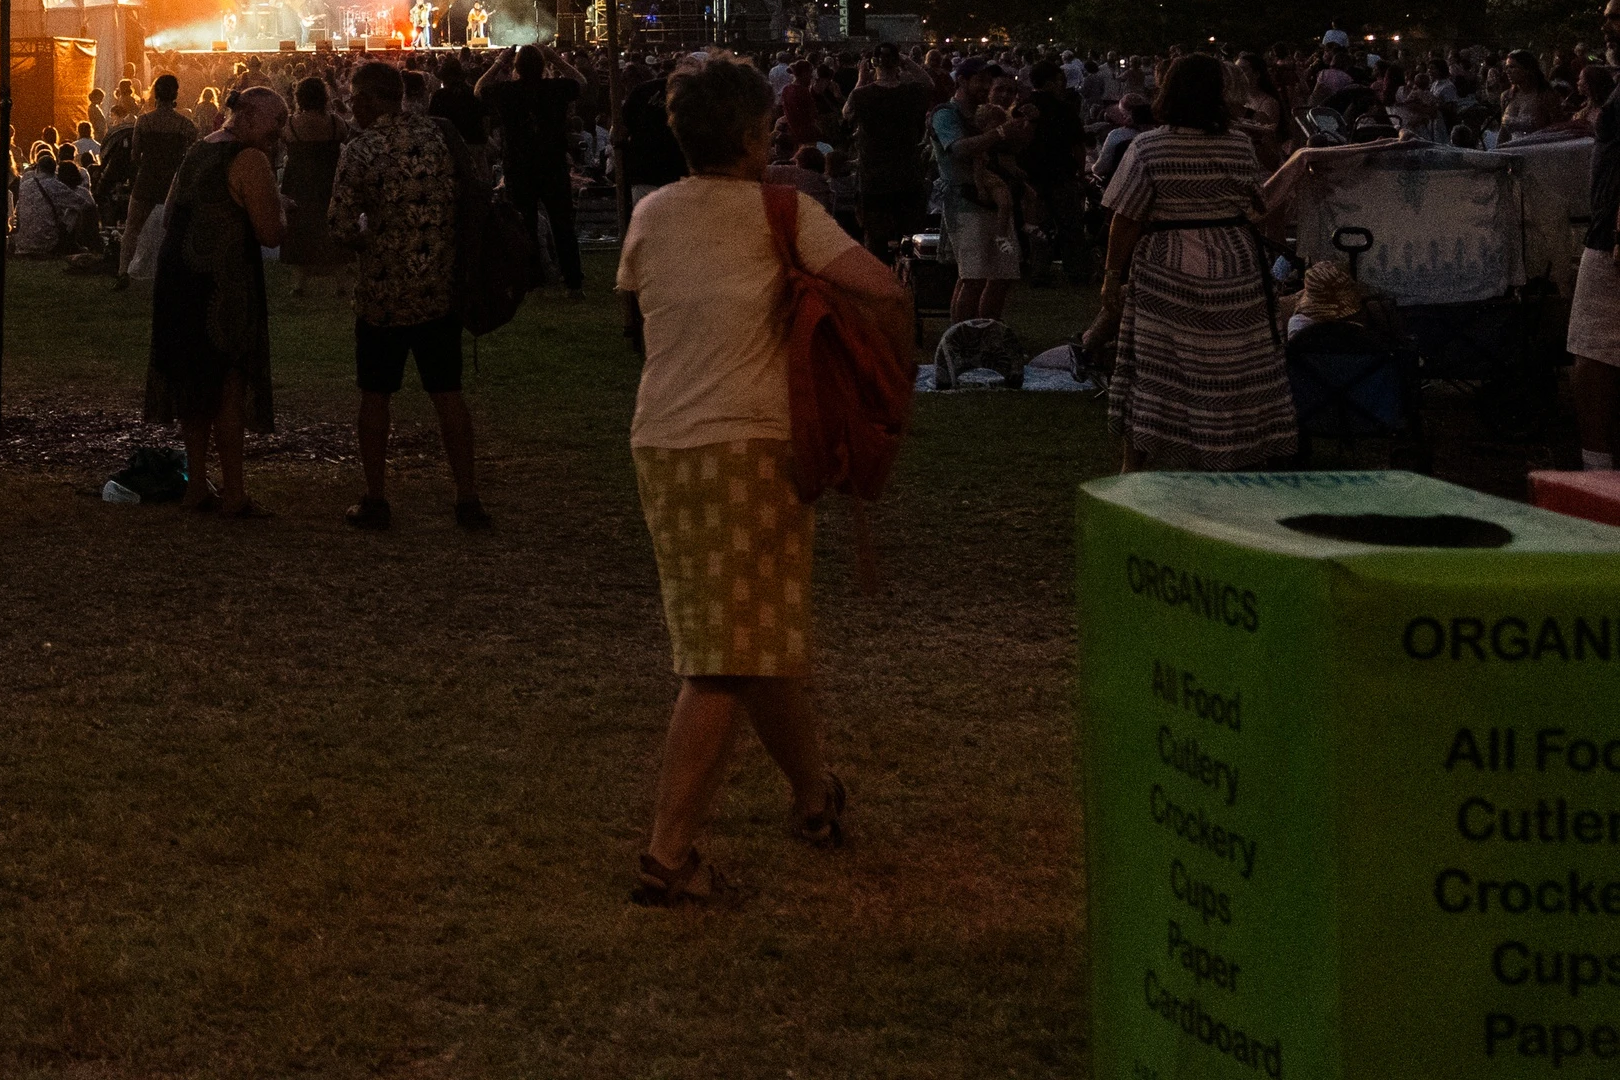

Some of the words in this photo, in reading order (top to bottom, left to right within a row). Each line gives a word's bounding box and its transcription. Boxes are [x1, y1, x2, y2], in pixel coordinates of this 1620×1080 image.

[1128, 554, 1259, 633] ORGANICS
[1153, 659, 1178, 704] All
[1183, 671, 1242, 732] Food
[1157, 725, 1239, 806] Cutlery
[1444, 727, 1516, 771] All
[1150, 784, 1256, 879] Crockery
[1170, 859, 1231, 924] Cups
[1168, 919, 1240, 993] Paper
[1144, 969, 1282, 1079] Cardboard
